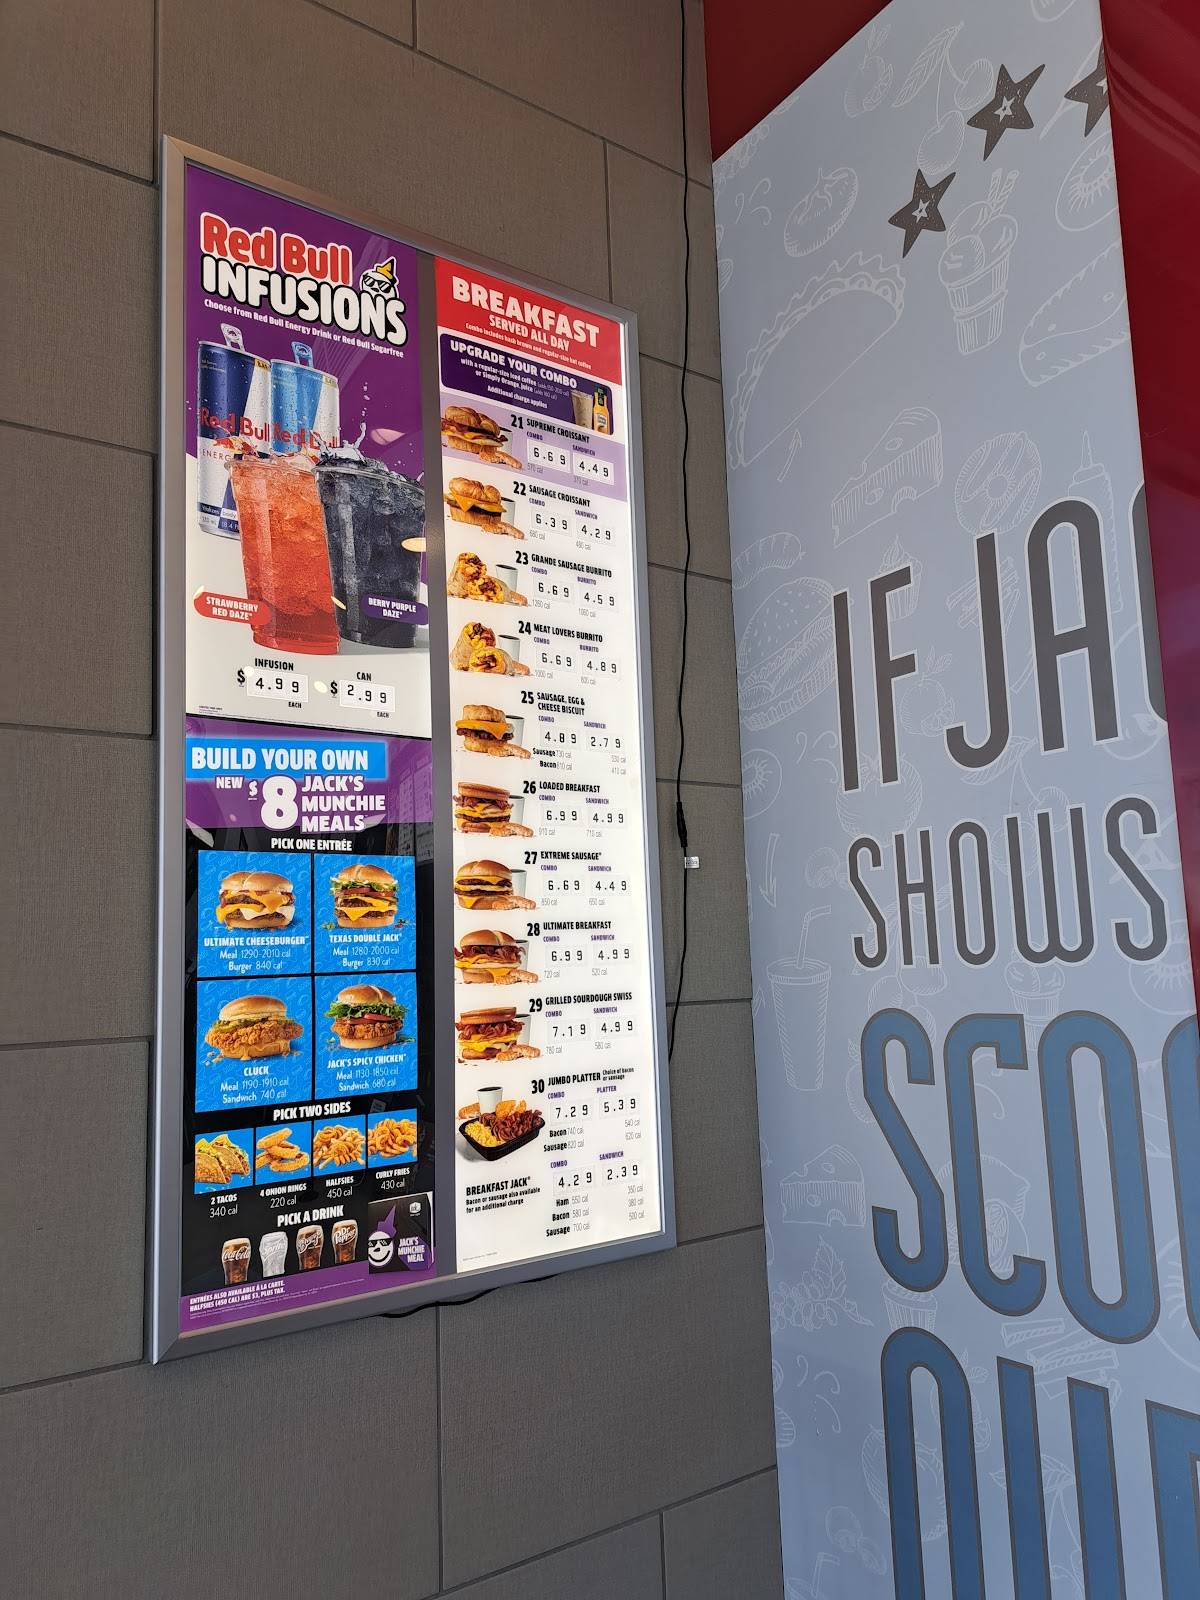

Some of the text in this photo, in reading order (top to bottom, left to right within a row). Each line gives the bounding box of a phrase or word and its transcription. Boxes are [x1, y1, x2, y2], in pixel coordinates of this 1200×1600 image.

[200, 212, 352, 286] Red Bull
[201, 254, 408, 346] INFUSIONS
[452, 276, 599, 347] BREAKFAST
[204, 299, 232, 314] Choose
[234, 305, 252, 318] from
[254, 310, 267, 322] Red
[269, 313, 283, 327] Bull
[285, 318, 310, 335] Energy
[312, 327, 331, 339] Drink
[342, 335, 355, 346] Red
[356, 338, 370, 349] Bull
[371, 342, 403, 358] Sugarfree
[489, 315, 569, 351] SERVED ALL DAY
[451, 340, 577, 389] UPGRADE YOUR COMBO
[201, 408, 269, 441] Red Bull
[511, 414, 590, 443] 21 SUPREME CROISSANT
[202, 450, 230, 462] ENERG
[513, 481, 590, 507] 22 SAUSAGE CROISSANT
[516, 551, 612, 578] 23 GRANDE SAUSAGE BURRITO
[206, 596, 258, 613] STRAWBERRY
[369, 598, 416, 613] BERRY PURPLE
[213, 607, 227, 617] RED
[519, 621, 603, 642] 24 MEAT LOVERS BURRITO
[255, 658, 293, 671] INFUSION
[357, 672, 371, 681] CAN
[832, 565, 916, 793] IF
[521, 691, 534, 704] 25
[537, 692, 566, 704] SAUSAGE,
[568, 696, 579, 705] EGG
[538, 703, 584, 715] CHEESE BISCUIT
[192, 747, 368, 770] BUILD YOUR OWN
[216, 777, 243, 789] NEW
[302, 776, 364, 792] JACK'S
[523, 781, 600, 794] 26 LOADED BREAKFAST
[302, 795, 385, 812] MUNCHIE
[271, 838, 352, 850] PICK ONE ENTRÉE
[524, 851, 537, 864] 27
[541, 851, 570, 859] EXTREME
[848, 797, 1168, 969] SHOWS
[527, 921, 611, 936] 28 ULTIMATE BREAKFAST
[204, 937, 244, 947] ULTIMATE
[330, 935, 351, 943] TEXAS
[354, 934, 381, 942] DOUBLE
[220, 949, 291, 959] Meal 1290-2010 cal
[333, 946, 399, 956] Meal 1280-2000 cal
[529, 992, 632, 1012] 29 GRILLED SOURDOUGH SWISS
[327, 1059, 351, 1069] JACK'S
[353, 1057, 372, 1066] SPICY
[244, 1065, 269, 1076] CLUCK
[336, 1066, 398, 1080] Meal 1130-1850 cal
[220, 1077, 289, 1092] Meal 1190-1910 cal
[531, 1072, 600, 1094] 30 JUMBO PLATTER
[273, 1102, 350, 1121] PICK TWO SIDES
[376, 1168, 409, 1179] CURLY FRIES
[326, 1176, 353, 1187] HALFSIES
[381, 1179, 405, 1190] 430 cal
[466, 1179, 509, 1196] BREAKFAST
[266, 1186, 285, 1196] ONION
[288, 1183, 306, 1193] RINGS
[327, 1187, 352, 1199] 450 cal
[217, 1194, 237, 1204] TACOS
[270, 1196, 296, 1208] 220 cal
[210, 1206, 237, 1217] 340 cal
[278, 1205, 343, 1227] PICK A DRINK
[399, 1237, 418, 1247] JACK'S
[398, 1245, 425, 1255] MUNCHIE
[408, 1254, 424, 1262] MEAL
